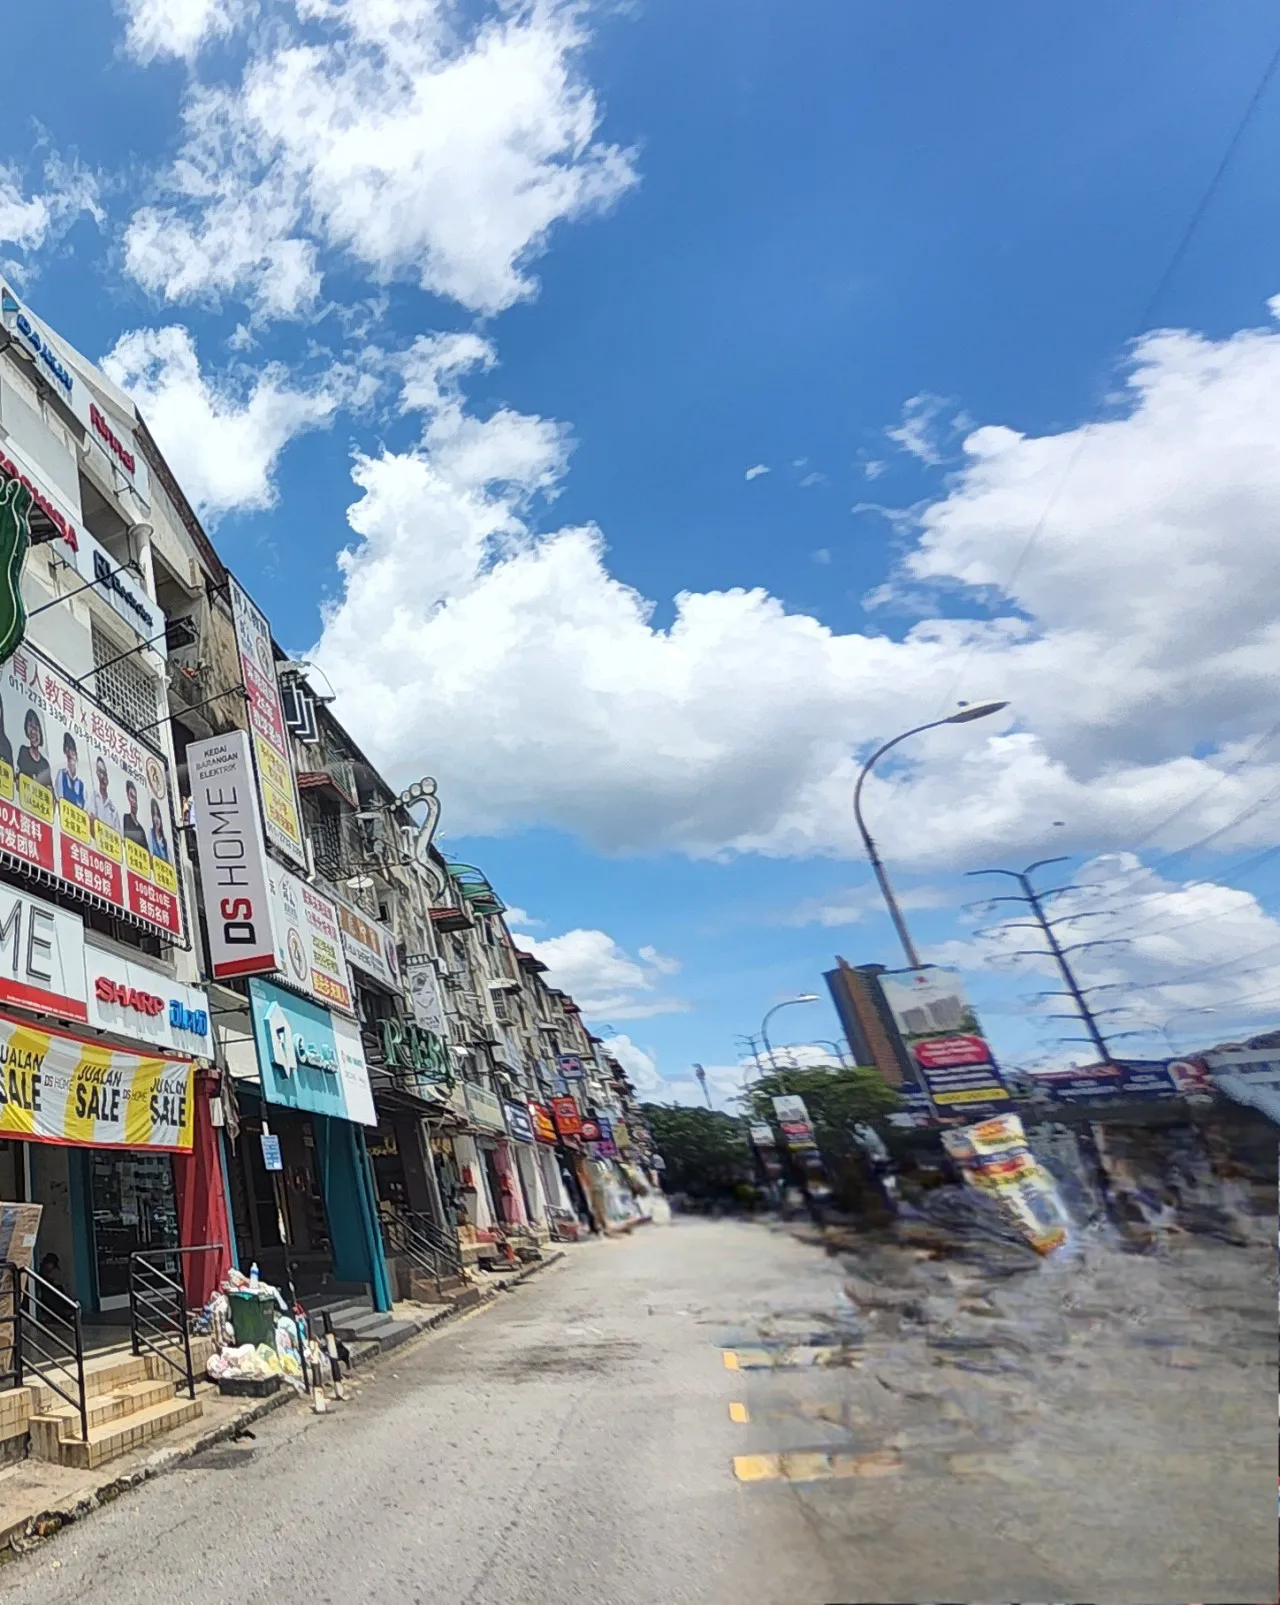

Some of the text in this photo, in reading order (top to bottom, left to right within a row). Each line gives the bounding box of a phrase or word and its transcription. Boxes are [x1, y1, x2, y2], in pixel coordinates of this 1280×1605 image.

[196, 753, 238, 770] BARANGAN
[204, 745, 227, 757] KEDAI
[200, 764, 236, 779] ELEKTRIK
[206, 786, 256, 945] DS HOME
[95, 976, 165, 1016] SHARP
[77, 1065, 123, 1086] JUALAN
[75, 1083, 120, 1122] SALE
[150, 1095, 187, 1127] SALE
